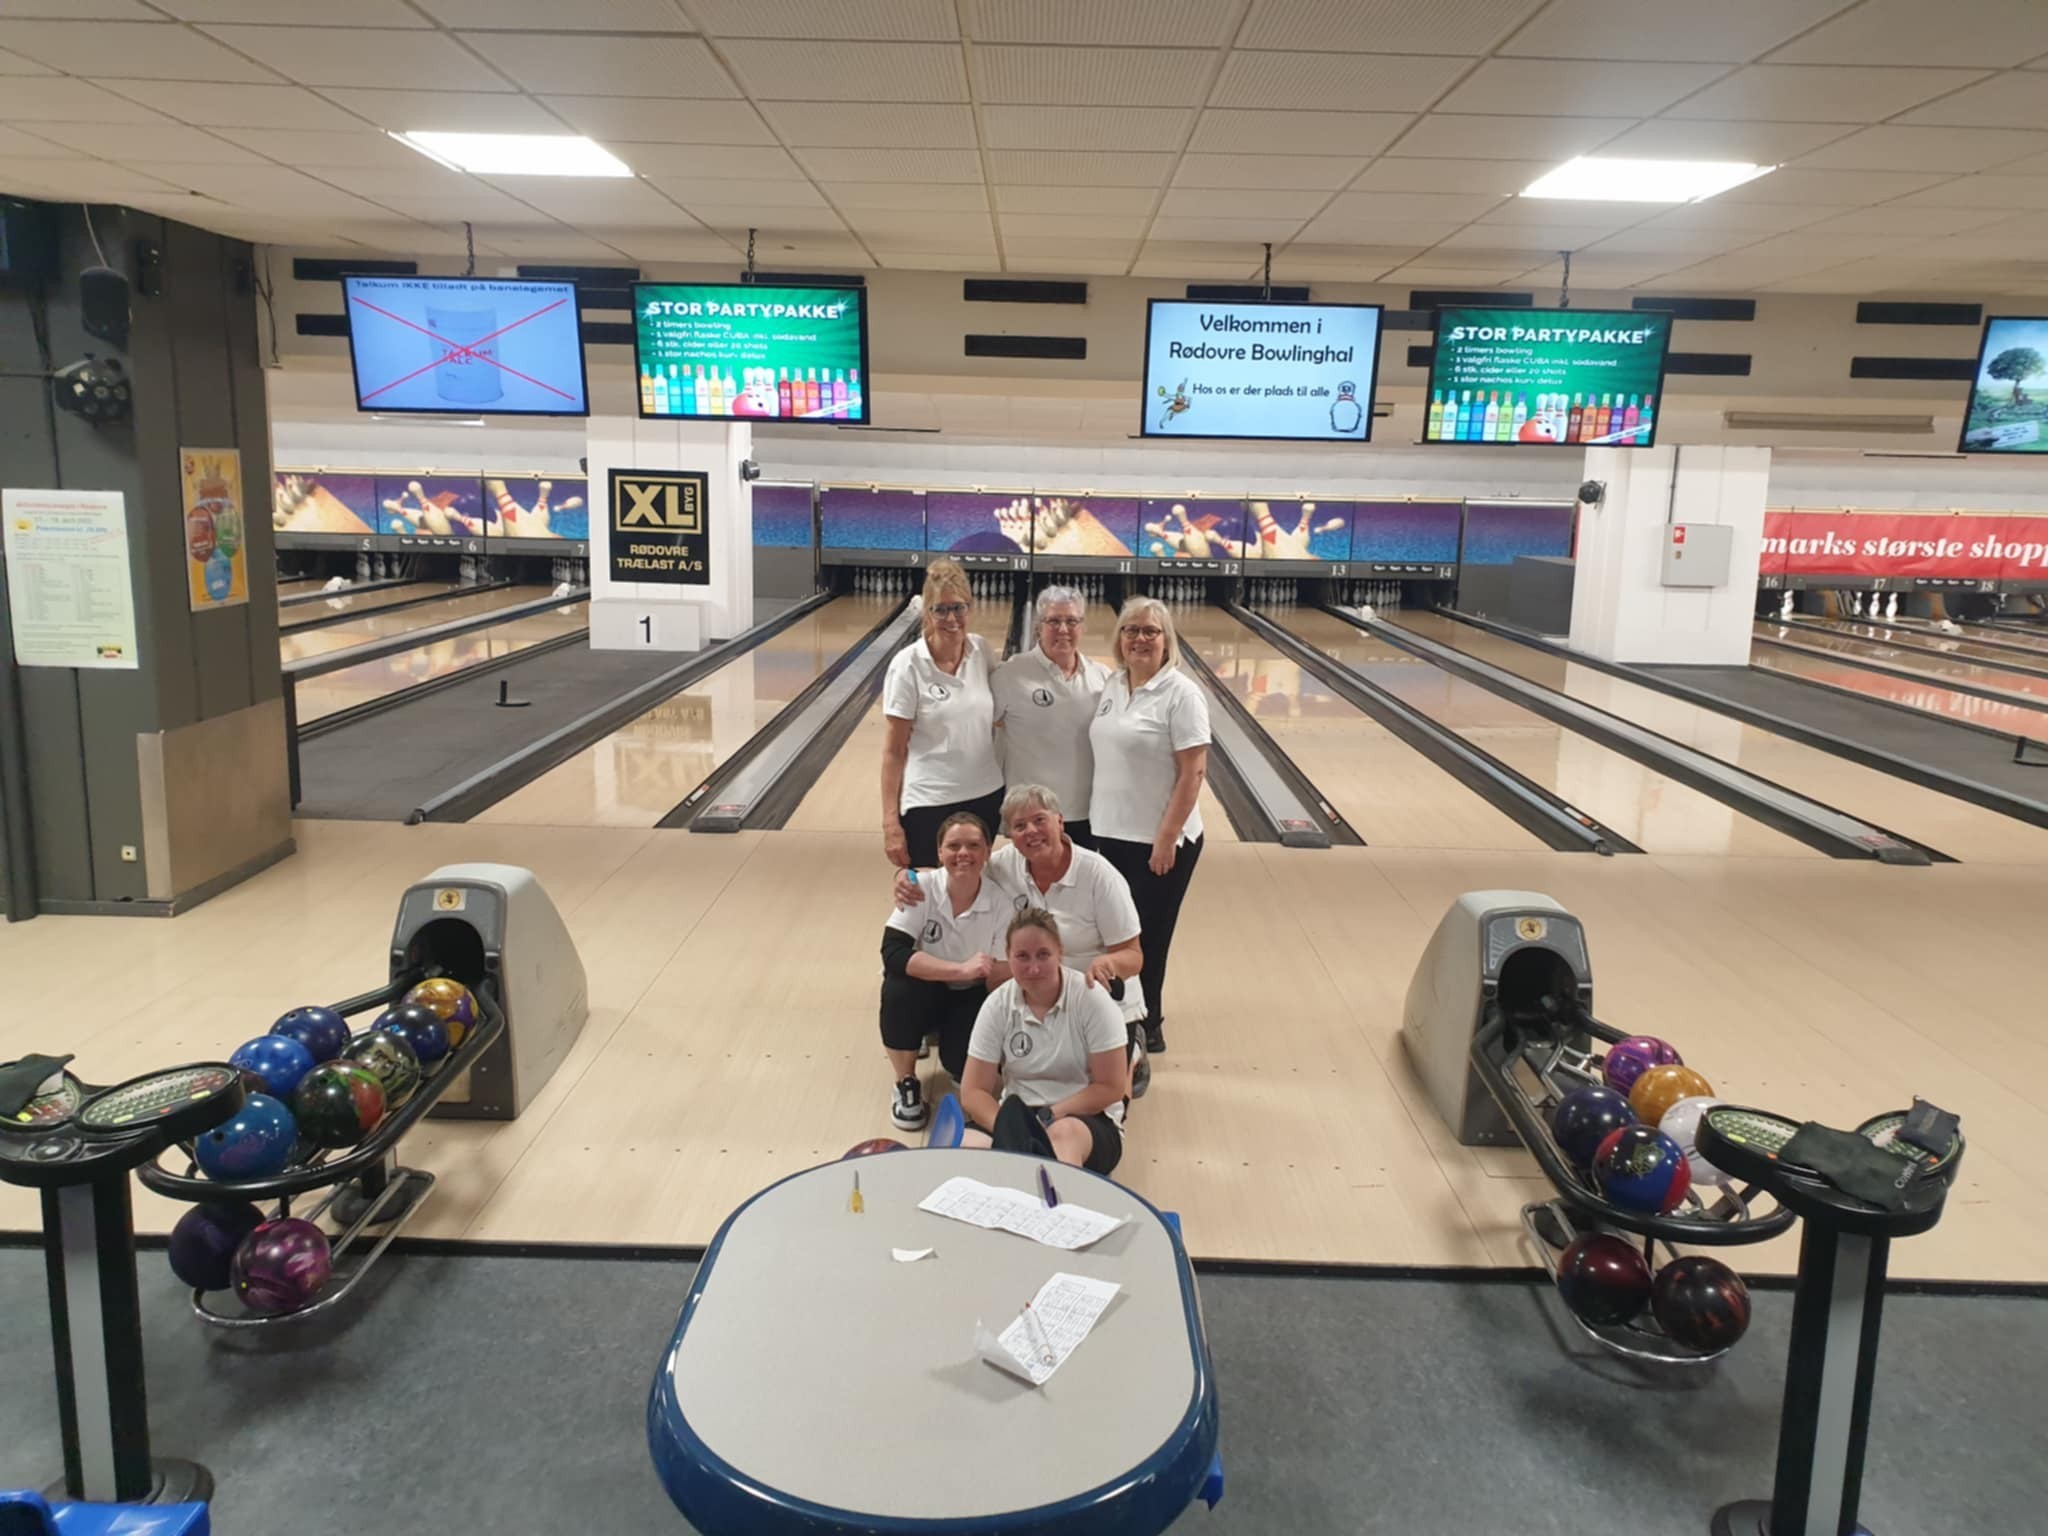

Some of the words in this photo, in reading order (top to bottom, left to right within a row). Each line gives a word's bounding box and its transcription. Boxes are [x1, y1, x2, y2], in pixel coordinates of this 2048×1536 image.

[648, 301, 702, 315] STOR
[707, 302, 839, 319] PARTYPAKKE
[694, 321, 731, 331] bowling
[1200, 314, 1311, 334] Velkommen
[1316, 318, 1323, 334] i
[1453, 326, 1507, 340] STOR
[1512, 327, 1644, 344] PARTYPAKKE
[1169, 342, 1246, 361] Rødovre
[1251, 343, 1354, 365] Bowlinghal
[1464, 345, 1493, 354] timers
[1496, 346, 1533, 356] bowling
[1523, 357, 1549, 365] CUBA
[1572, 359, 1617, 367] sodavand
[1480, 366, 1504, 374] cider
[1505, 367, 1527, 375] eller
[1460, 375, 1478, 383] stor
[1480, 375, 1512, 384] nachos
[1192, 383, 1213, 395] Hos
[1215, 386, 1227, 395] os
[1229, 387, 1240, 396] er
[1243, 384, 1261, 396] der
[1264, 385, 1294, 398] plads
[1296, 386, 1307, 397] til
[1310, 387, 1330, 398] alle
[621, 483, 695, 527] XL
[684, 487, 695, 512] BYG
[362, 538, 370, 550] 5
[468, 540, 477, 552] 6
[577, 544, 585, 555] 7
[1861, 537, 1964, 558] største
[629, 544, 689, 557] RØDOVRE
[617, 557, 676, 571] TRÆLAST
[678, 560, 703, 572] A/S
[911, 553, 919, 565] 9
[1013, 559, 1028, 570] 10
[1119, 561, 1132, 573] 11
[1224, 563, 1239, 575] 12
[1331, 564, 1346, 576] 13
[1438, 567, 1451, 578] 14
[1764, 576, 1778, 588] 16
[1873, 578, 1887, 590] 17
[1981, 580, 1995, 592] 18
[639, 616, 651, 643] 1
